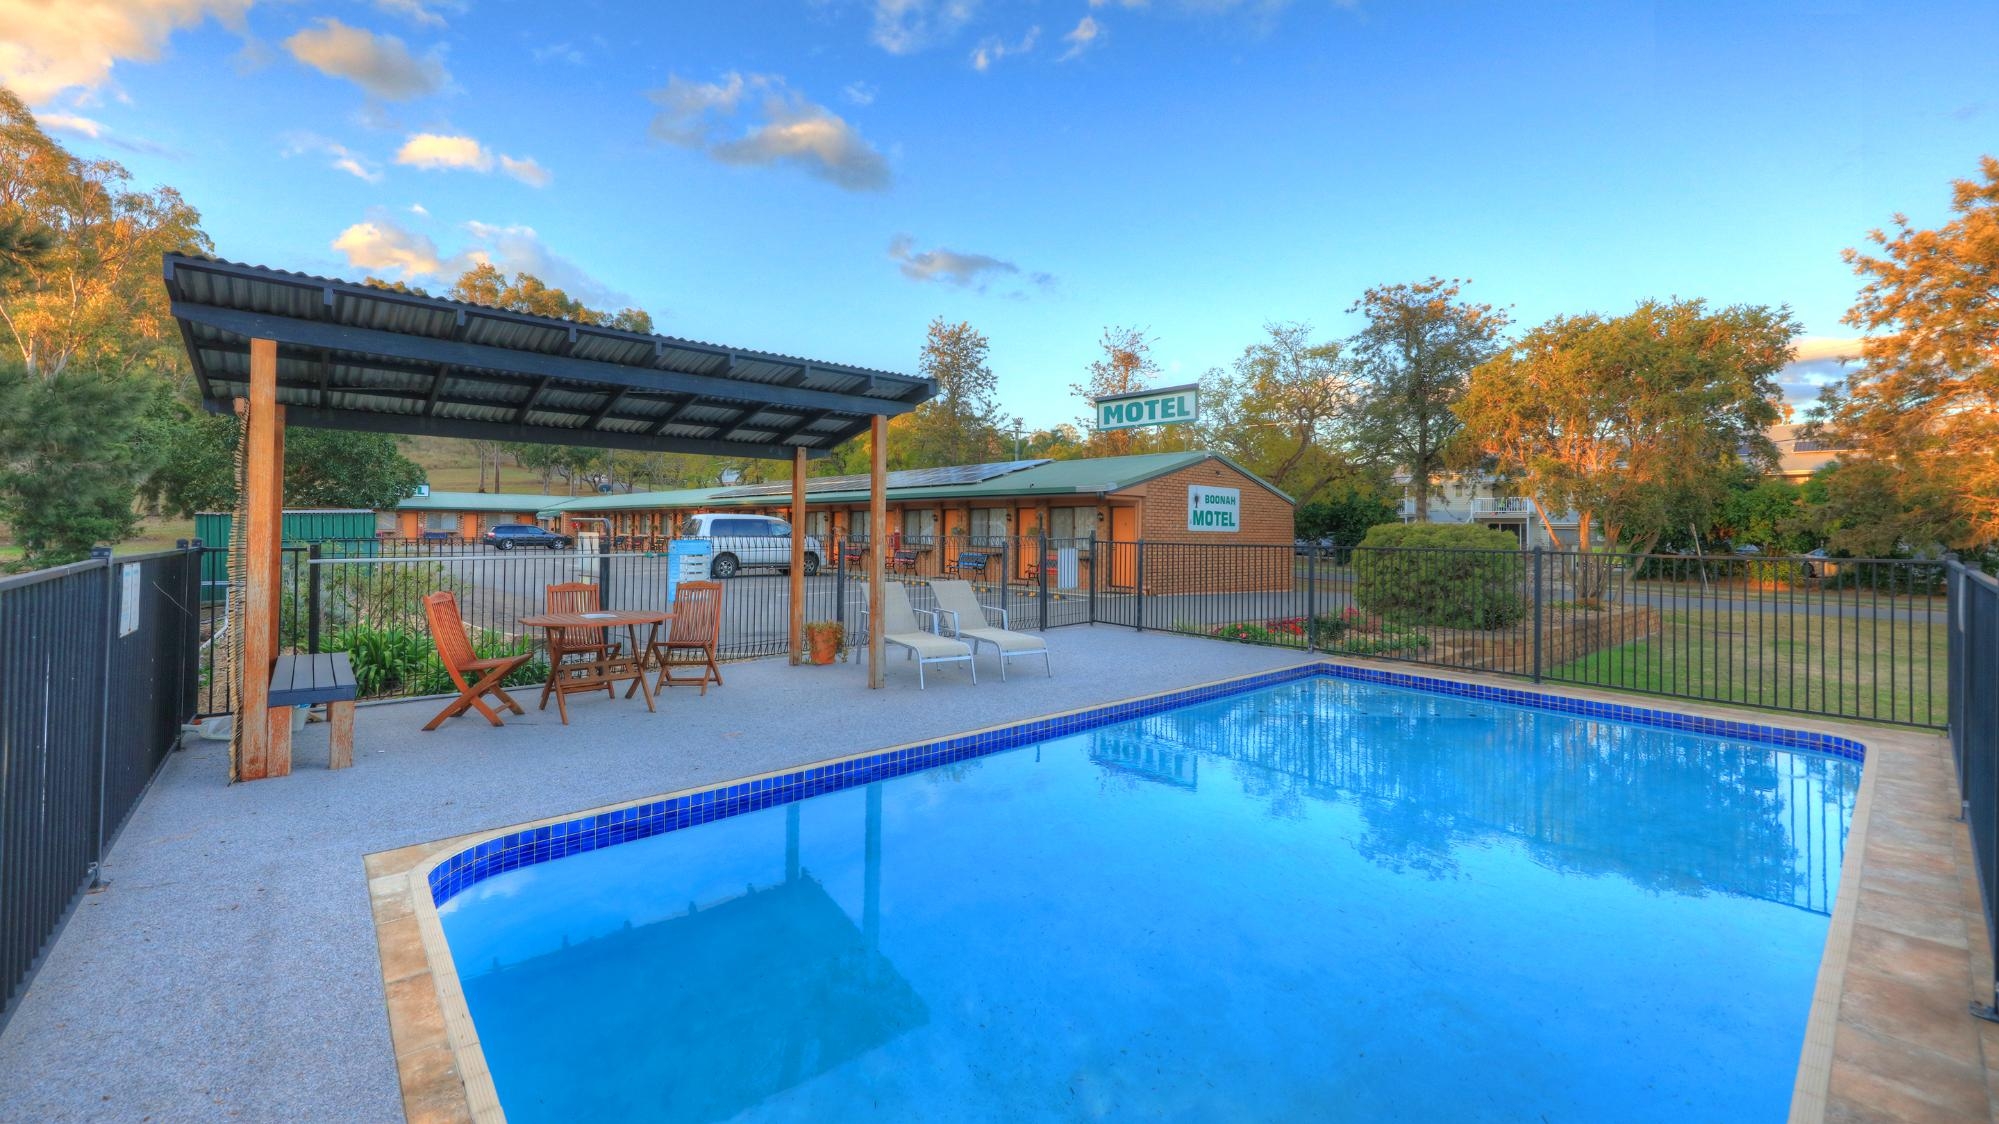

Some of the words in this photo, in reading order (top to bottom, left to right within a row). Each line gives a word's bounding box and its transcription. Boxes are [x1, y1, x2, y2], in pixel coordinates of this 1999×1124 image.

[1103, 396, 1190, 425] MOTEL
[1204, 494, 1236, 505] BOONAH
[1192, 510, 1236, 527] MOTEL
